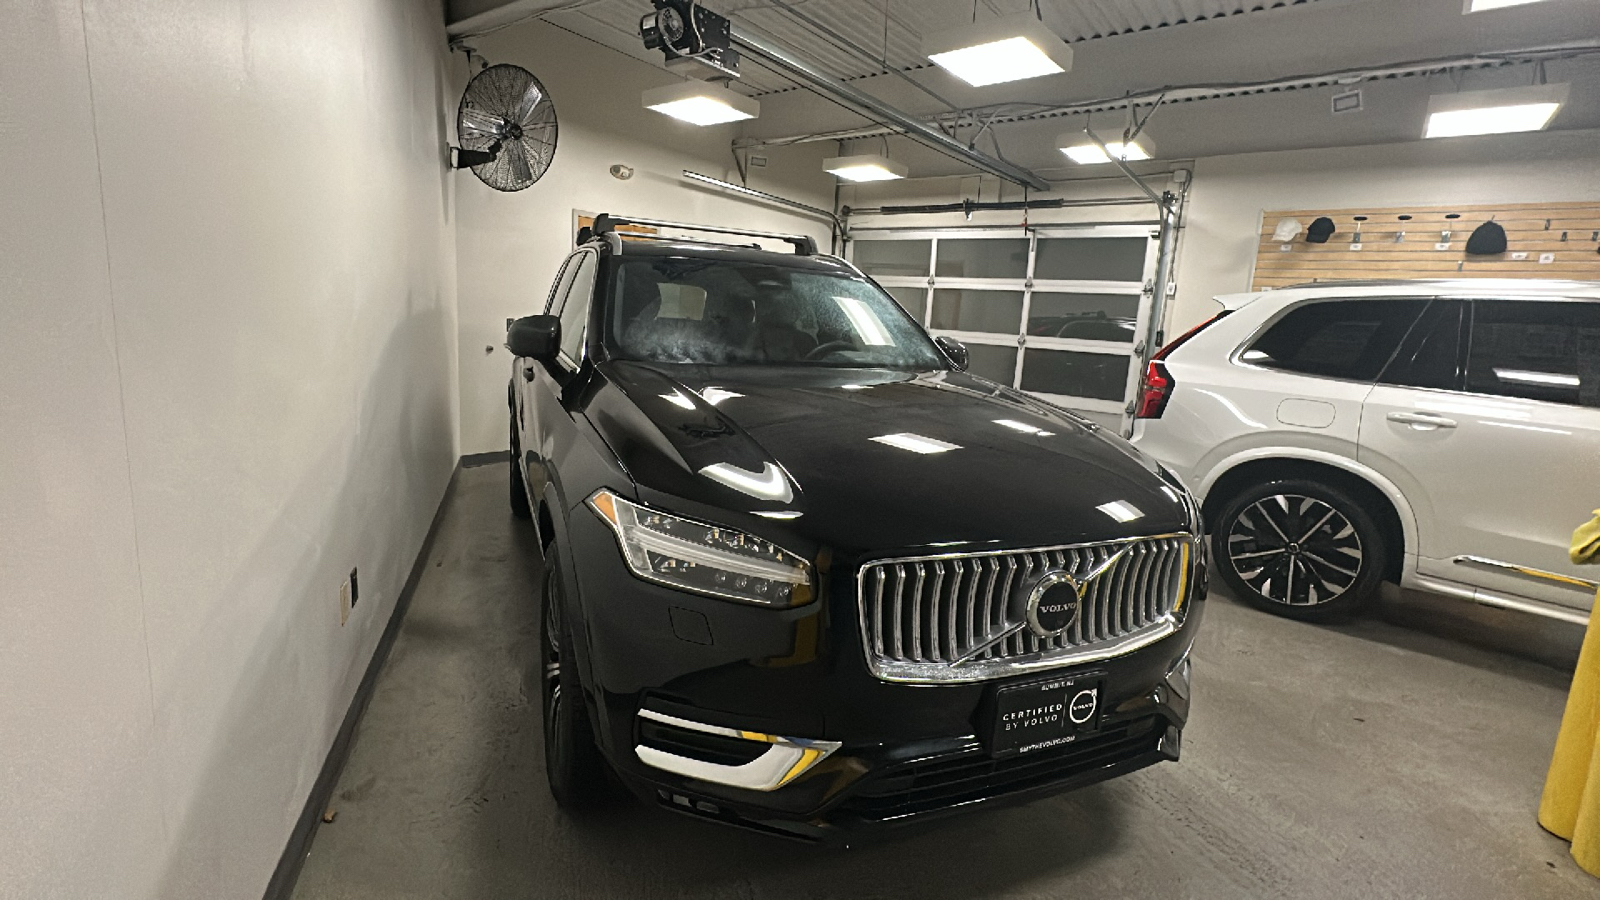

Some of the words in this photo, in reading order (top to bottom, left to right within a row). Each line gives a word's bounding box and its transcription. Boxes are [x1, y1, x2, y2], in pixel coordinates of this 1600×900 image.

[1040, 602, 1077, 613] VOLVO
[1003, 704, 1062, 721] CERTIFIED
[1073, 703, 1094, 711] VOLVO
[1005, 721, 1019, 731] BY
[1024, 715, 1058, 728] VOLVO
